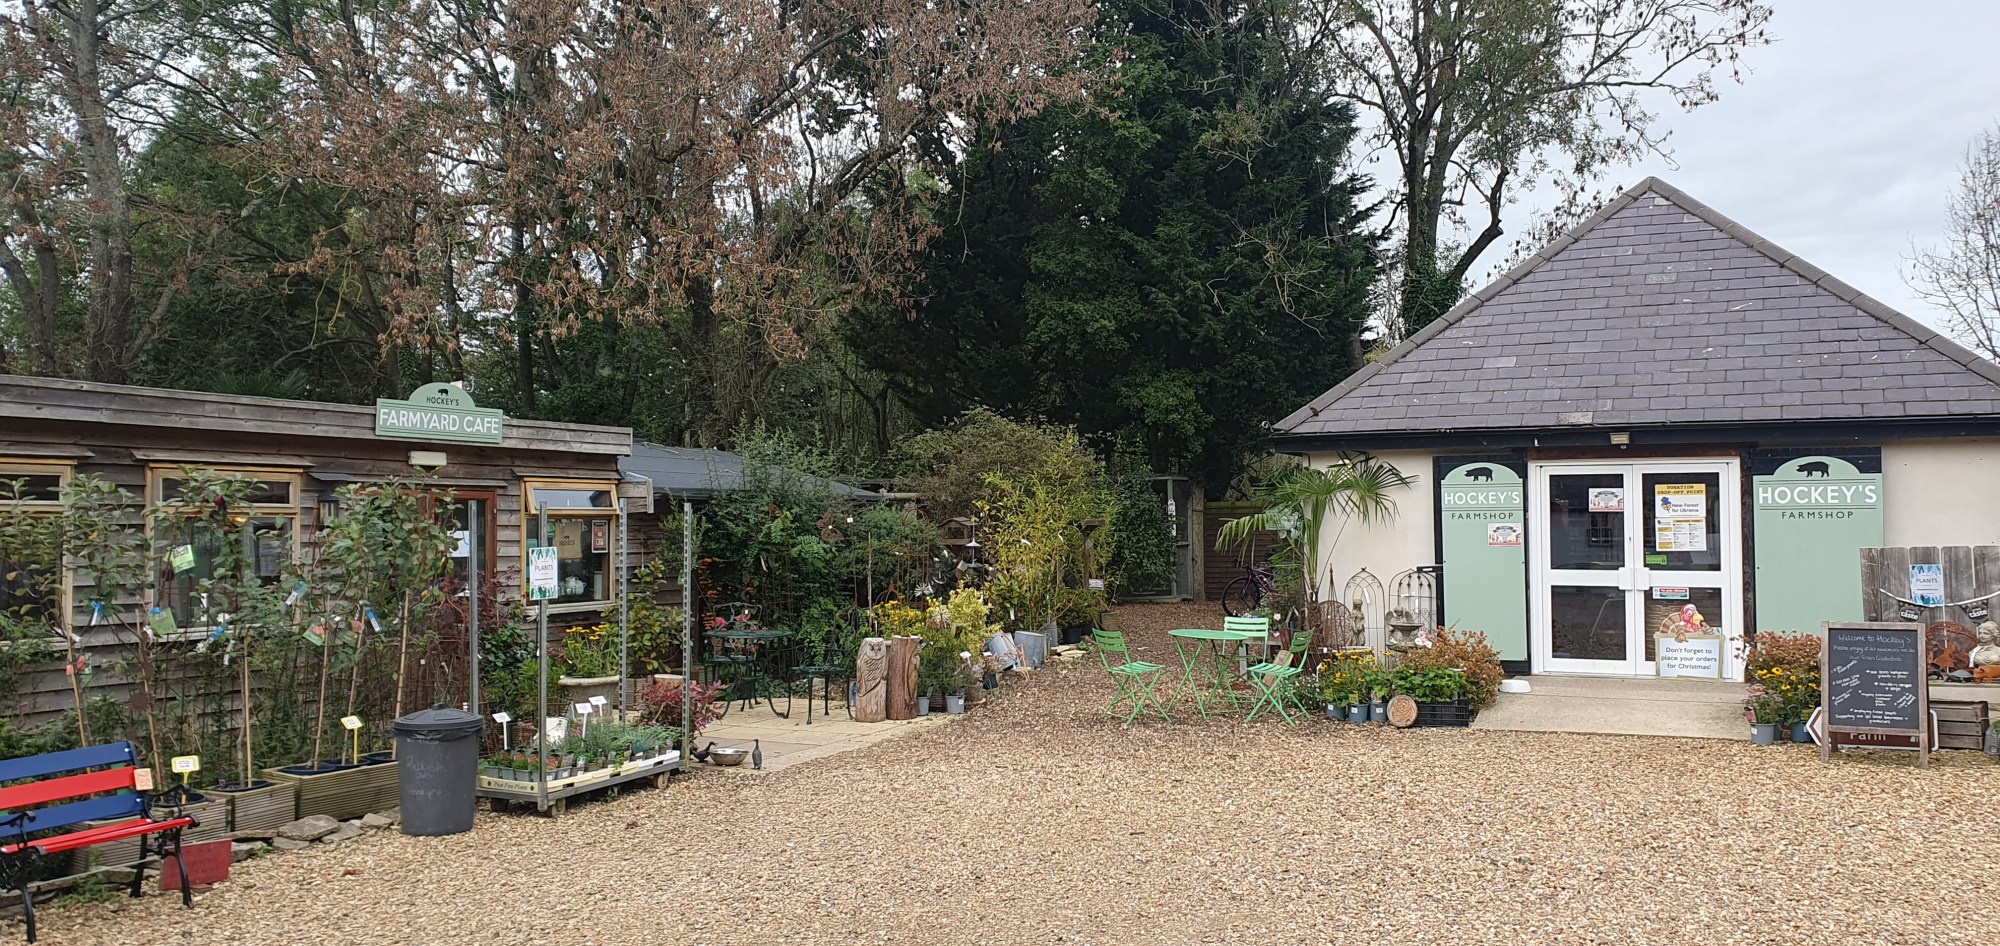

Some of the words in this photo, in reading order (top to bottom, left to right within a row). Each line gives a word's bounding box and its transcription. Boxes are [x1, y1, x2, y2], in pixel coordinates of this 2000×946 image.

[426, 396, 459, 406] HOCKEY'S
[379, 409, 459, 431] FARMYARD
[463, 416, 499, 433] CAFE
[1444, 491, 1520, 505] HOCKEY'S
[1758, 485, 1877, 504] HOCKEY'S
[1452, 512, 1514, 520] FARMSHOP
[1782, 511, 1854, 519] FARMSHOP
[1838, 634, 1866, 642] Welcome
[1877, 634, 1911, 648] Hockey's
[1684, 647, 1704, 655] forget
